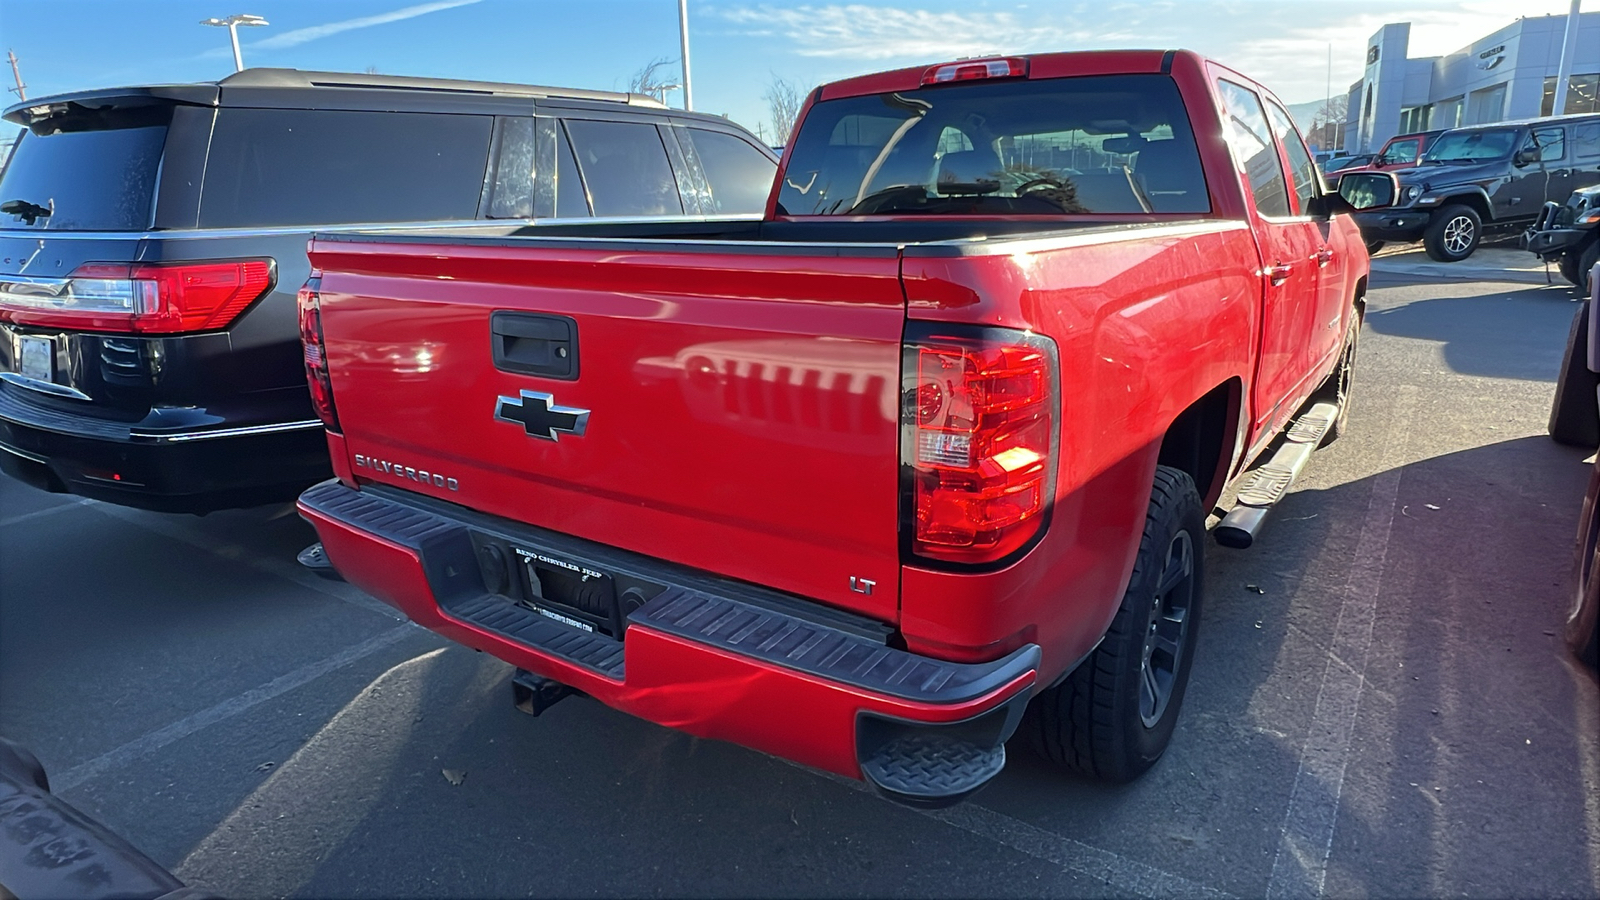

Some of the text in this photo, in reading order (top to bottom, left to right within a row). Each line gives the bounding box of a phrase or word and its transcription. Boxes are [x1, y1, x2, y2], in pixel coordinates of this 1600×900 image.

[355, 454, 459, 491] SILVERADO
[515, 548, 602, 578] RENO CHRYSLER JEEP
[850, 576, 876, 595] LT
